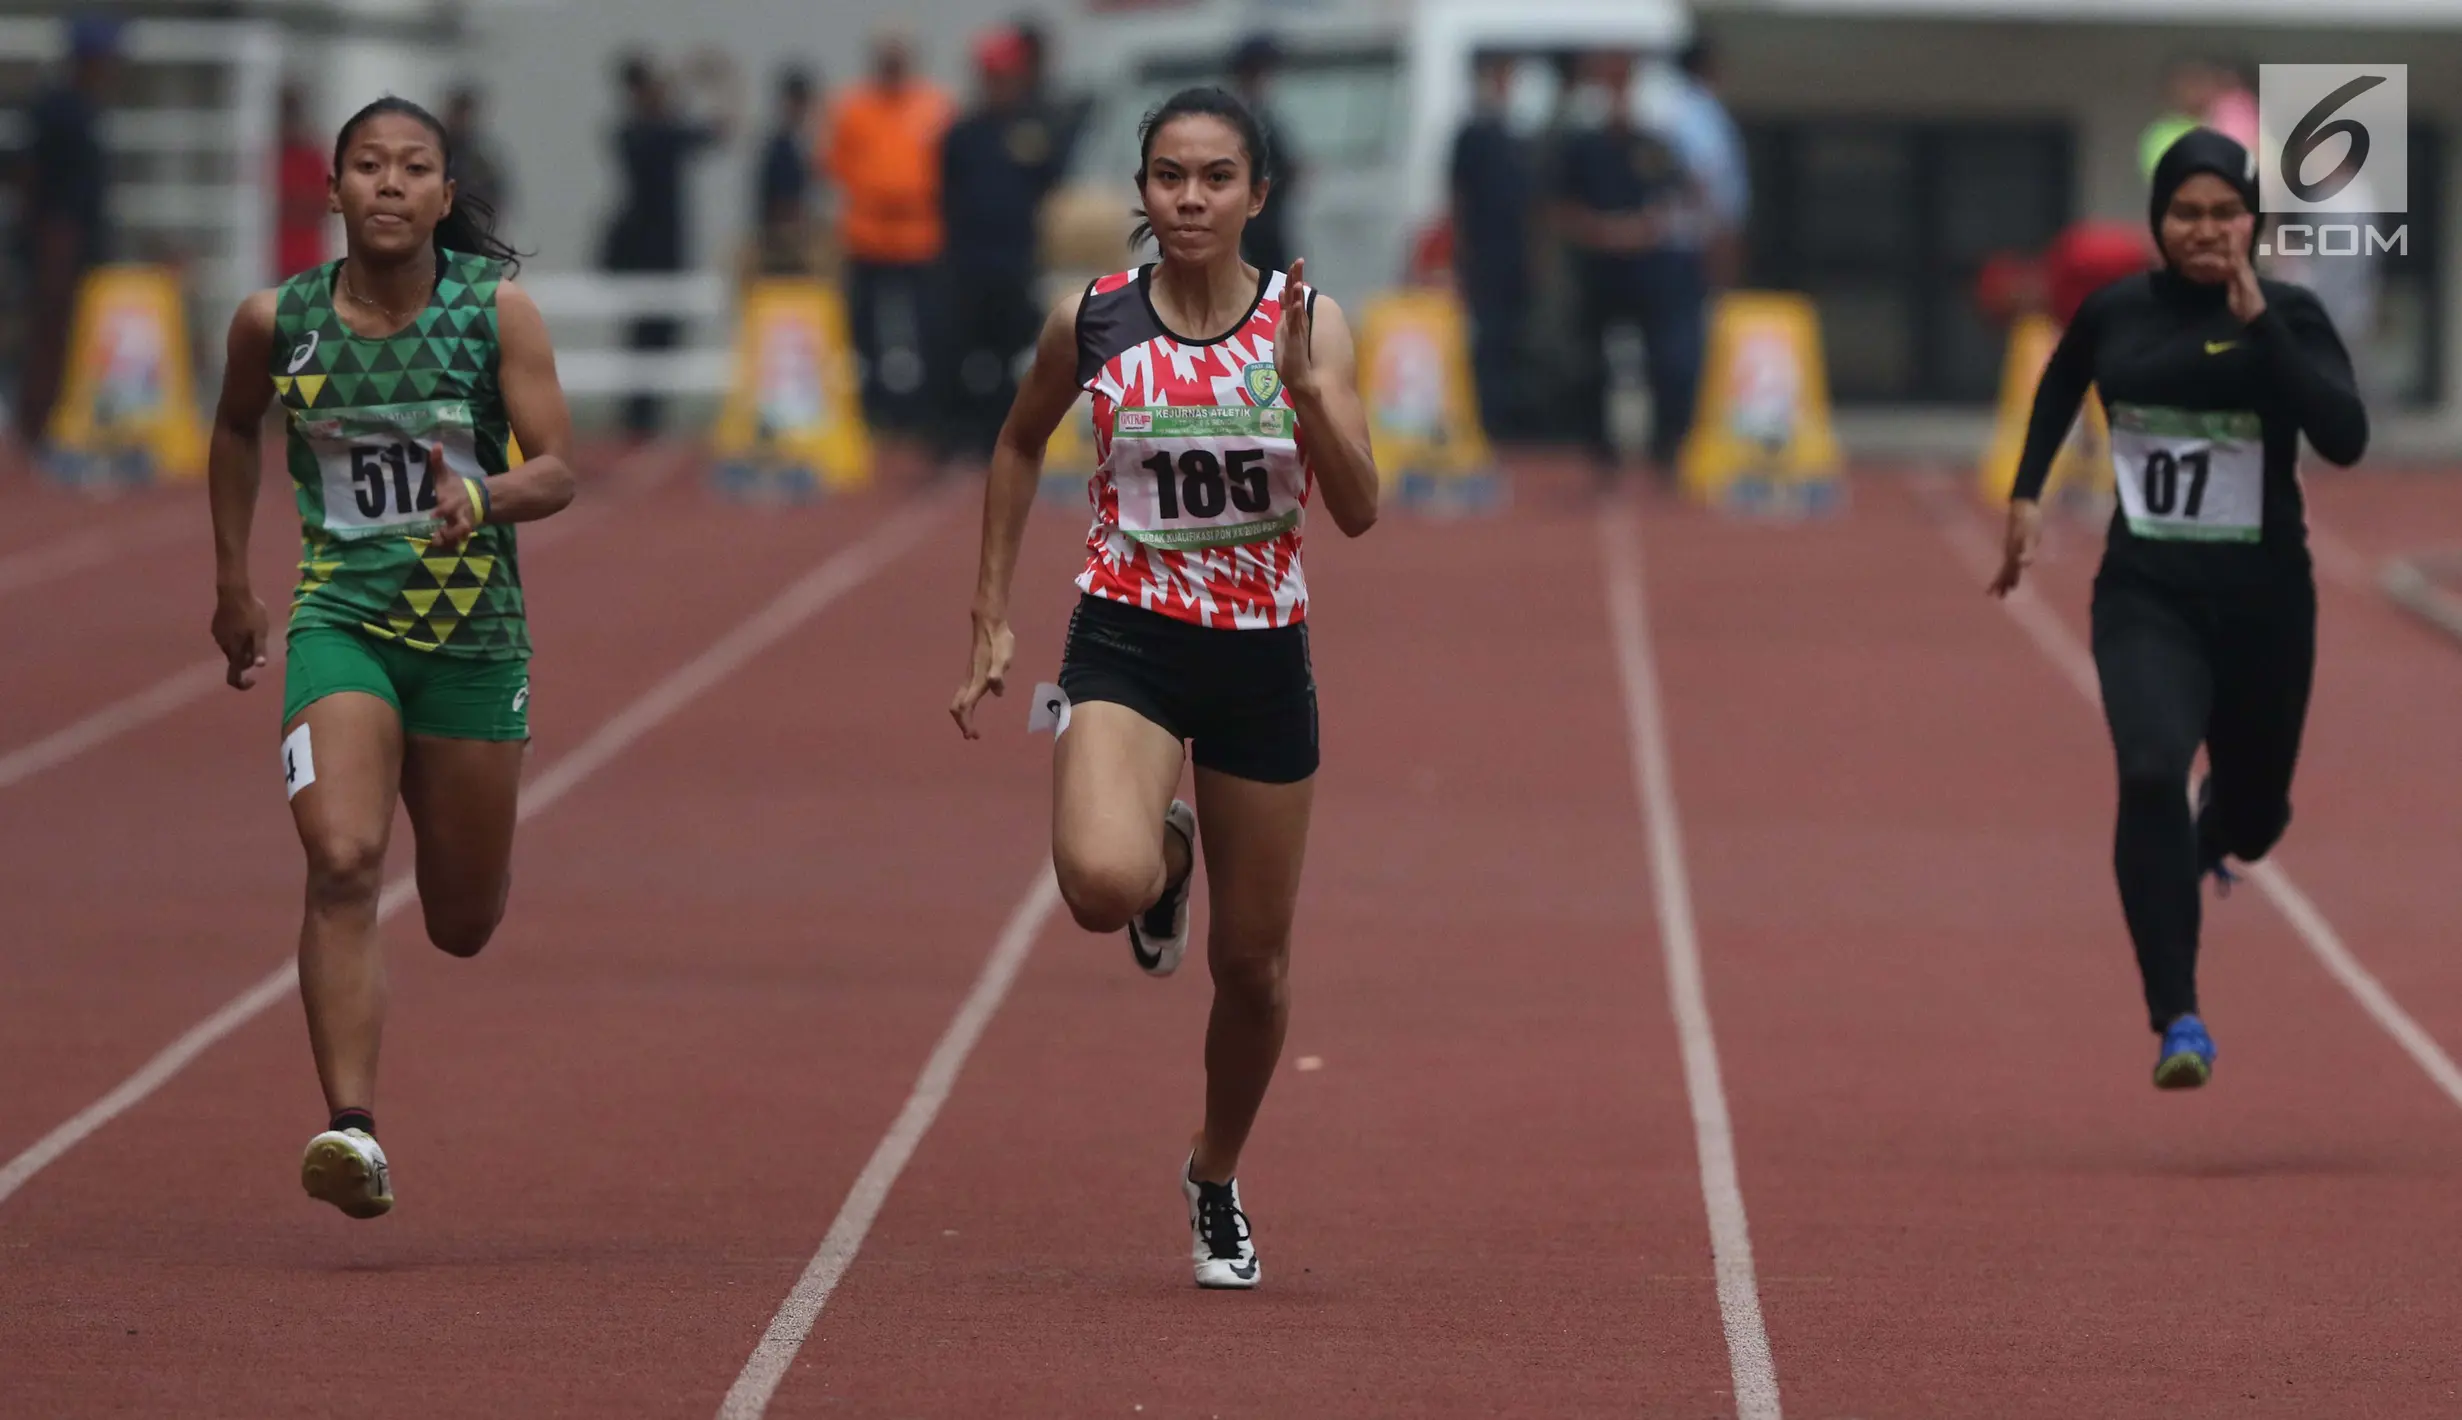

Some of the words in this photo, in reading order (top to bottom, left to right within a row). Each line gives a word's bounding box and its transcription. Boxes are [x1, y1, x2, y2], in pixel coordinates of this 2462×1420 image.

[1155, 408, 1208, 419] KEJURNAS
[1211, 407, 1251, 418] ATLETIK
[350, 440, 438, 519] 512
[1142, 449, 1271, 520] 185
[2144, 448, 2211, 519] 07
[1166, 529, 1213, 544] KUALIFIKASI
[1215, 528, 1232, 541] PON
[1232, 526, 1244, 539] XX
[1244, 523, 1262, 537] 2020
[286, 748, 296, 783] 4
